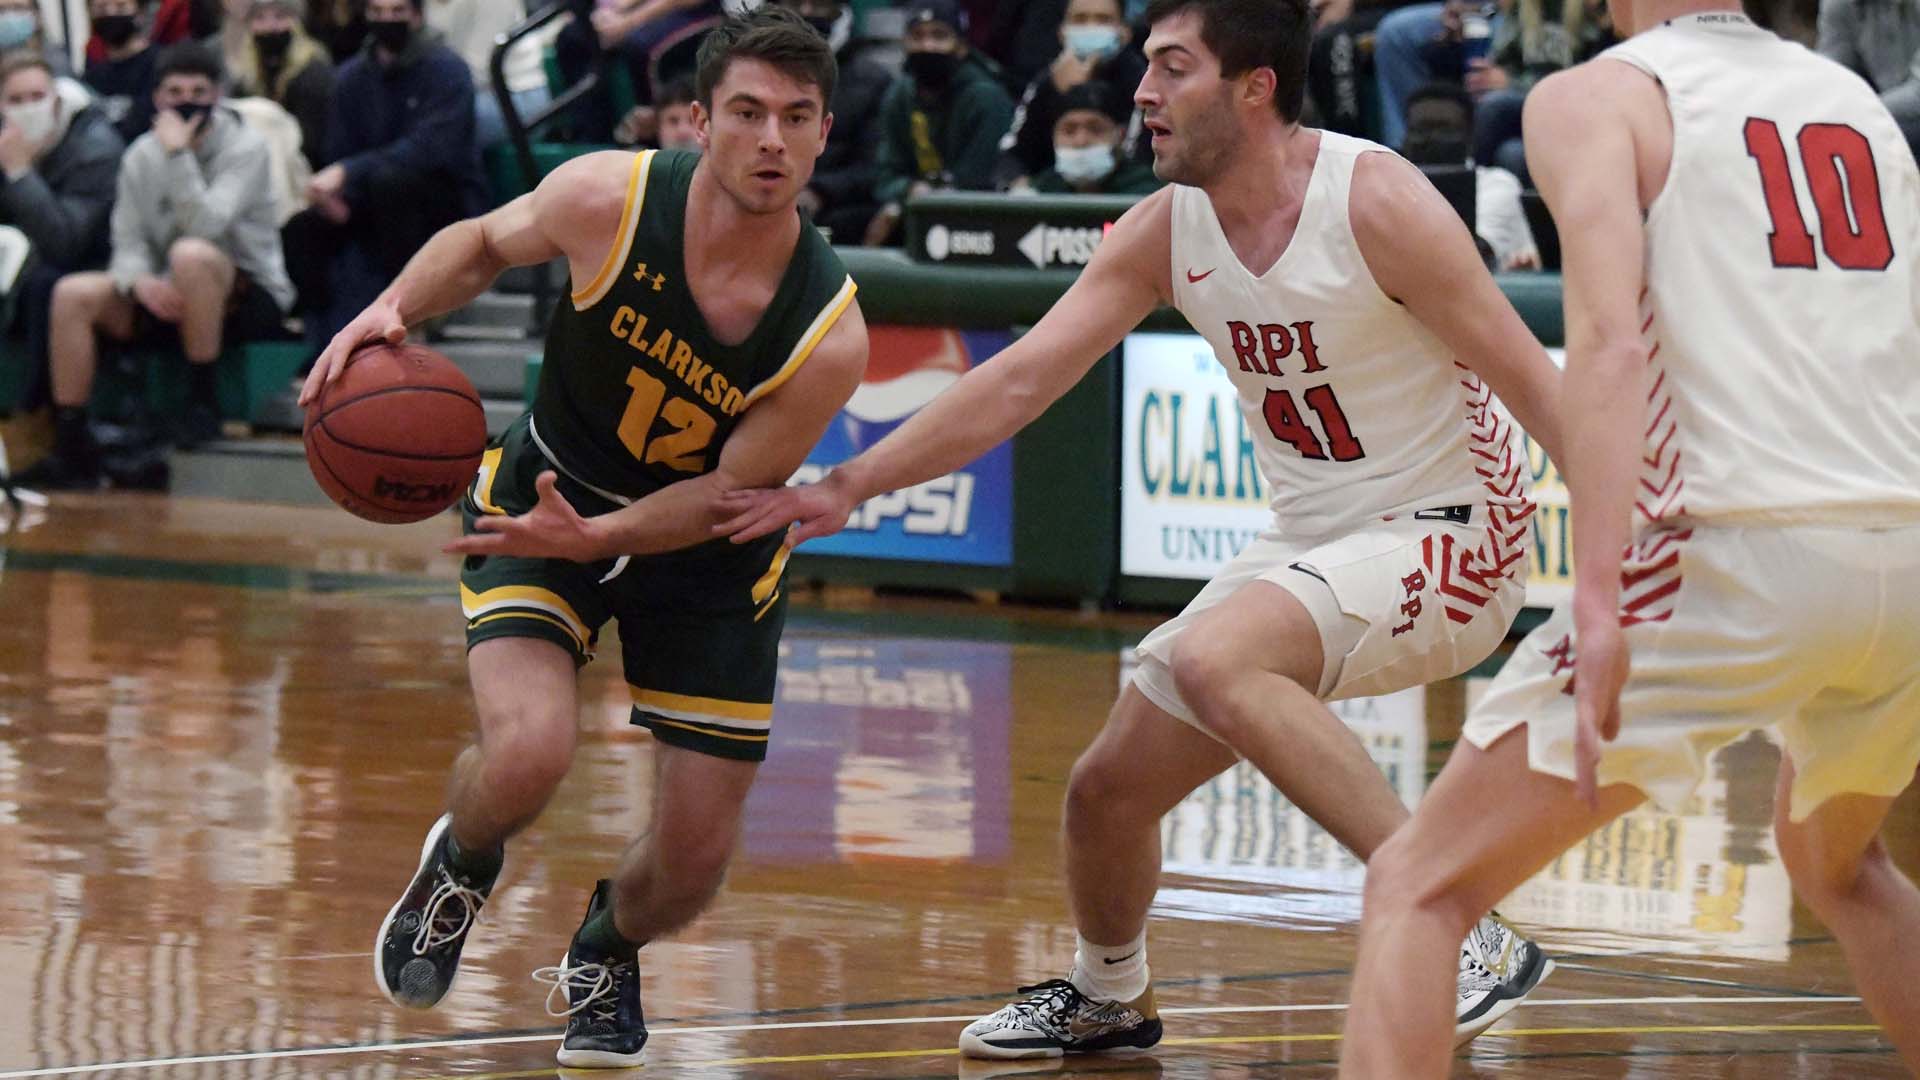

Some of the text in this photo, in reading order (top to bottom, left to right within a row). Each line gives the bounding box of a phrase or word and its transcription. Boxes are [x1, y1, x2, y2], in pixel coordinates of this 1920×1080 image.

[1742, 116, 1895, 272] 10
[951, 230, 995, 255] BONUS
[1048, 227, 1105, 264] POSS
[609, 304, 746, 417] CLARKSO
[1226, 320, 1329, 377] RPI
[616, 365, 718, 473] 12
[1140, 389, 1263, 499] CLAR
[1262, 383, 1366, 463] 41
[1161, 525, 1258, 562] UNIV
[1391, 568, 1427, 638] RPI
